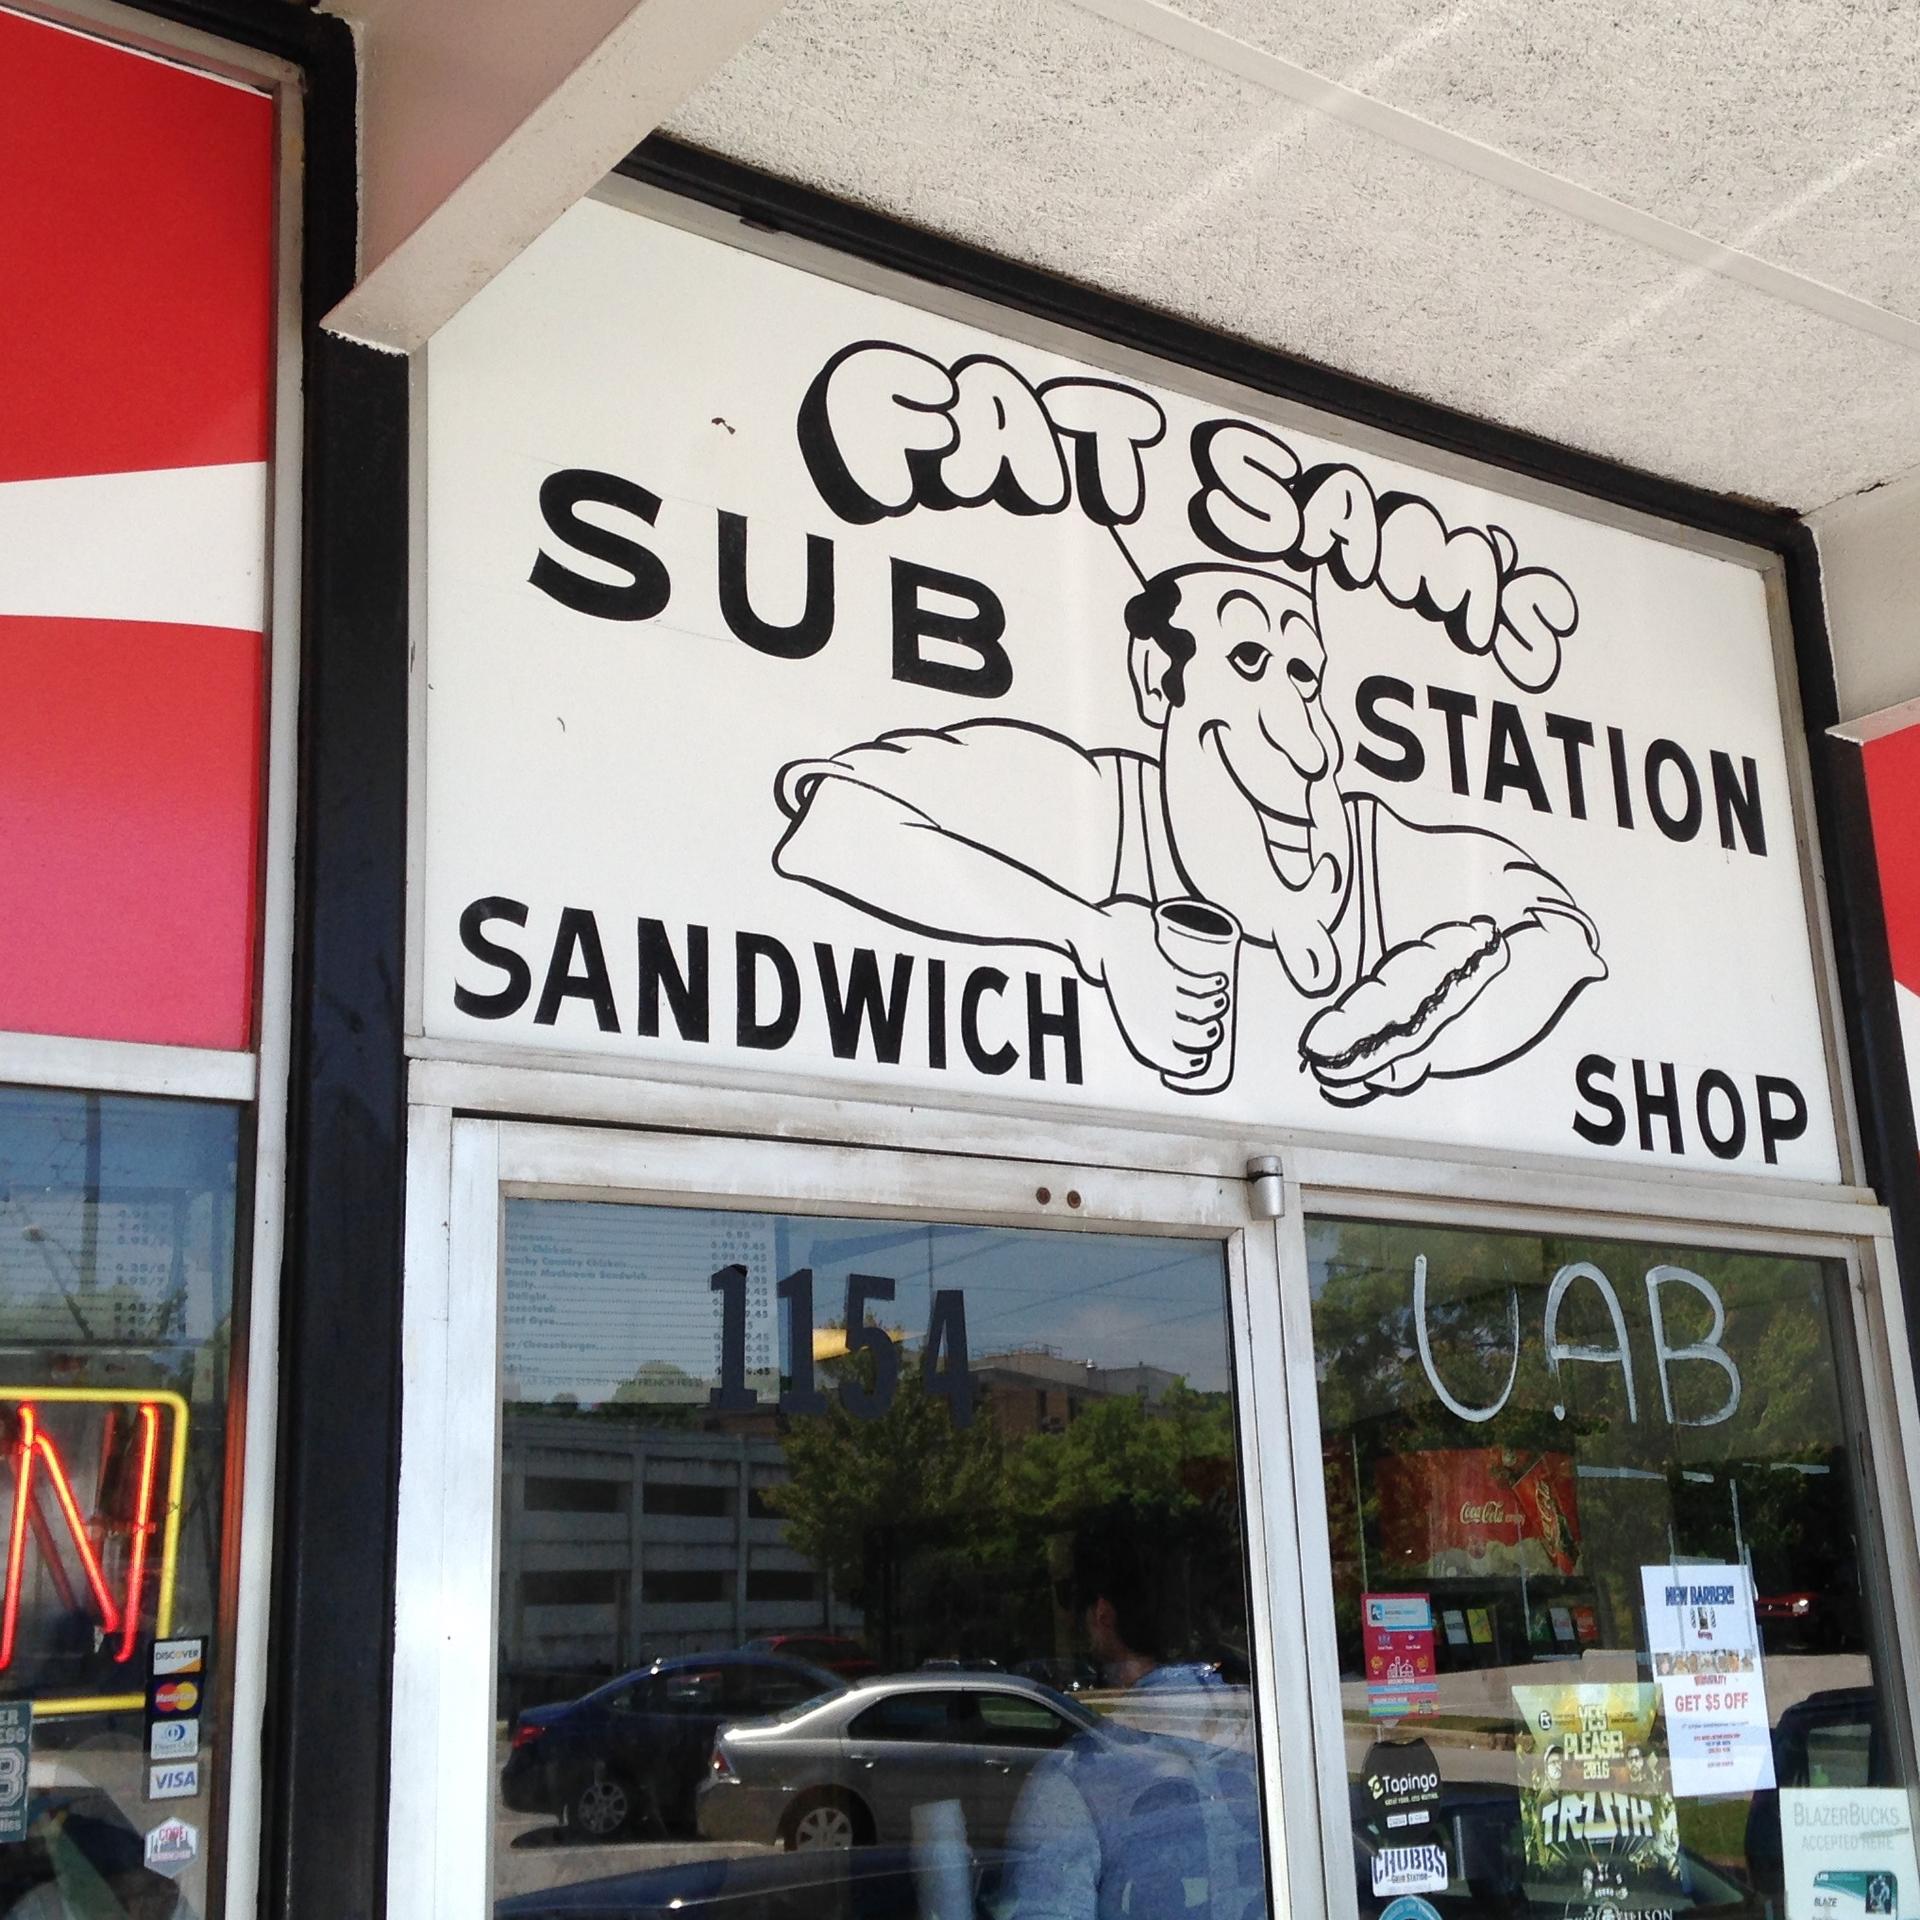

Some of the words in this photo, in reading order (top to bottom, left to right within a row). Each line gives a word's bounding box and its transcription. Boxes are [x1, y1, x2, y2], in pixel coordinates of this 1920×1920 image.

[797, 340, 1167, 526] FAT
[1188, 419, 1579, 694] SAM'S
[527, 468, 1013, 699] SUB
[1354, 674, 1768, 857] STATION
[453, 895, 1083, 1085] SANDWICH
[1572, 1053, 1808, 1165] SHOP
[710, 1263, 979, 1428] 1154
[1414, 1253, 1741, 1426] UAB
[1665, 1586, 1688, 1606] NEW
[156, 1649, 198, 1660] DISCOVER
[1675, 1695, 1701, 1712] GET
[1706, 1693, 1720, 1711] $5
[1724, 1692, 1748, 1709] OFF
[156, 1771, 196, 1789] VISA
[1382, 1773, 1438, 1795] Tapingo
[1583, 1761, 1610, 1779] 2016
[1541, 1791, 1653, 1845] TRUTH
[1802, 1834, 1858, 1850] ACCEPTED
[1861, 1833, 1895, 1849] HERE
[1373, 1845, 1445, 1884] CHUBBS
[1814, 1896, 1839, 1907] BLAZE
